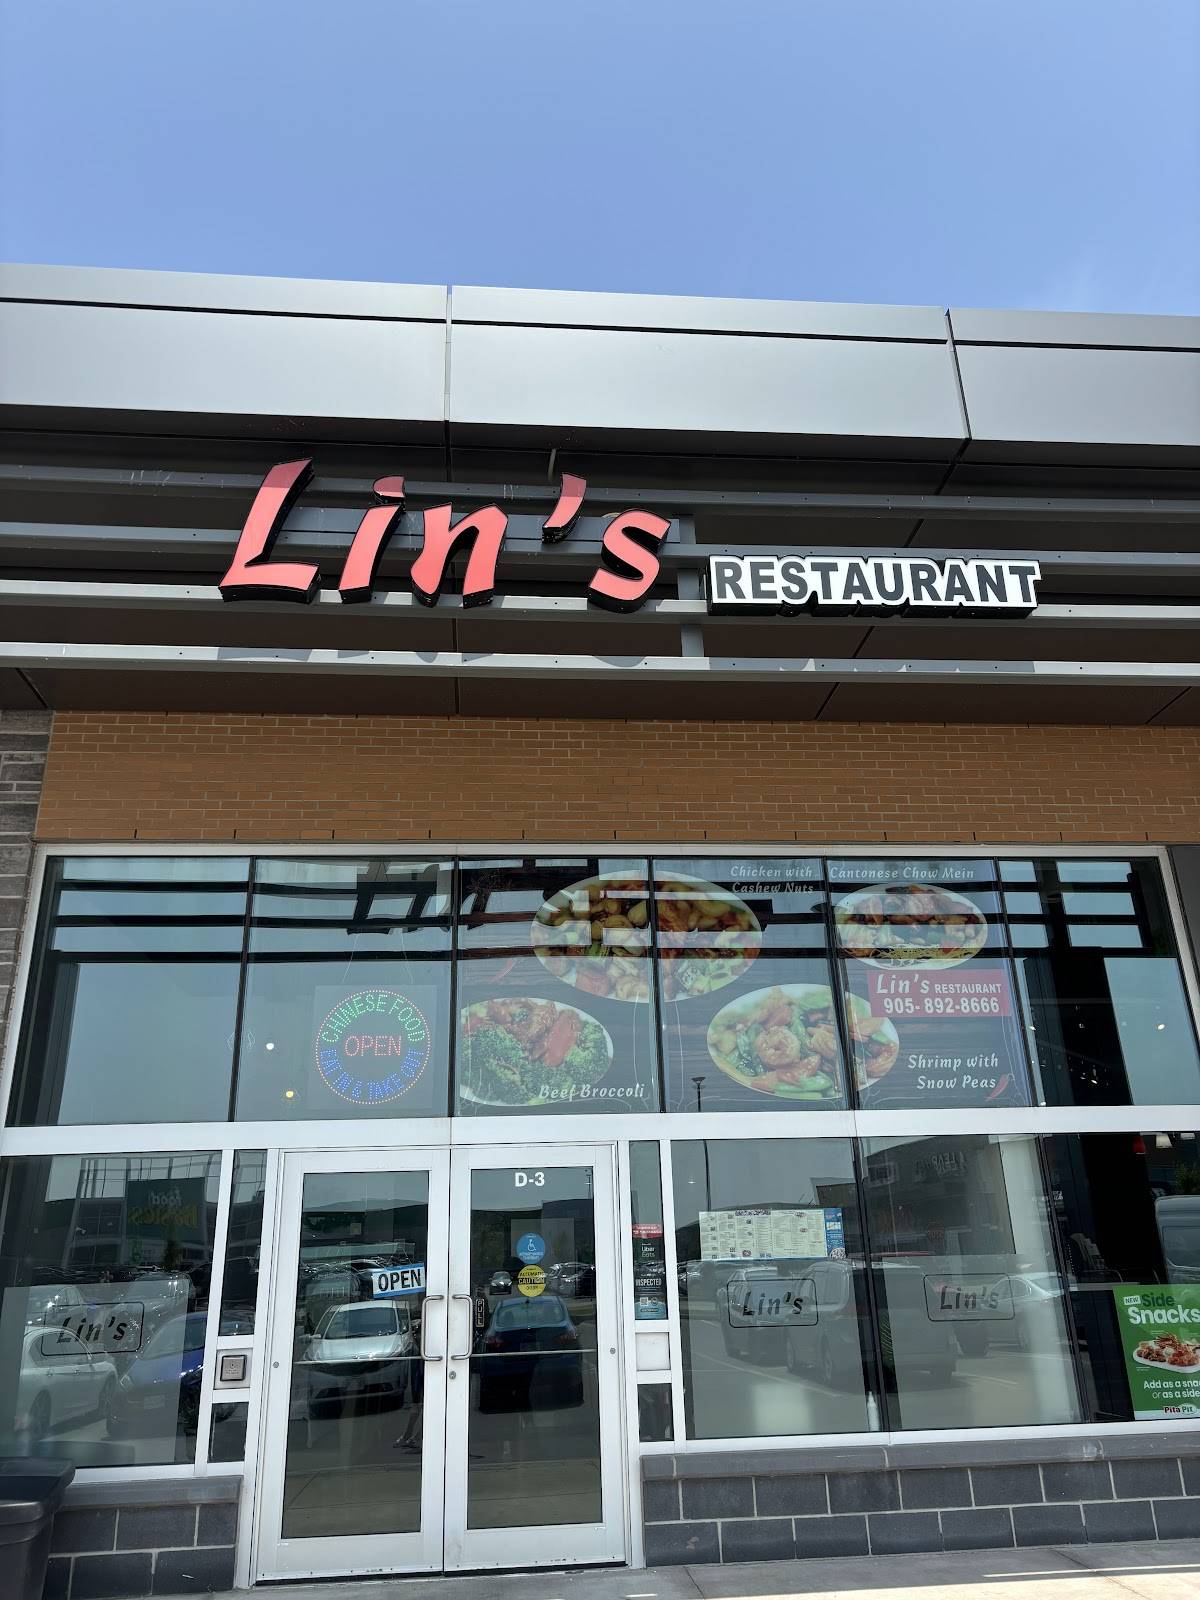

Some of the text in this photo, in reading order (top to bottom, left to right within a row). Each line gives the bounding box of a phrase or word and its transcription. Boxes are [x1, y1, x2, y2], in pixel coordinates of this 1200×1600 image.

[219, 457, 1037, 609] Lin's RESTAURANT
[730, 865, 813, 878] Chicken with
[830, 866, 975, 879] Cantonese Chow Mein
[732, 881, 815, 895] Cashew Nuts
[876, 973, 1002, 994] Lin's RESTAURANT
[321, 993, 426, 1043] CHINESE FOOD
[344, 1035, 402, 1057] OPEN
[907, 1053, 999, 1071] Shrimp with
[916, 1074, 997, 1090] Snow Peas
[539, 1083, 645, 1102] Beef Broccoli
[514, 1171, 545, 1187] D-3
[377, 1268, 422, 1292] OPEN
[742, 1291, 804, 1316] Lin's
[940, 1285, 999, 1310] Lin's
[1141, 1292, 1175, 1307] Side
[1128, 1304, 1200, 1324] Snacks
[56, 1316, 127, 1344] Lin's
[1143, 1380, 1161, 1389] Add
[1182, 1380, 1200, 1388] sna
[1152, 1391, 1161, 1399] or
[1182, 1389, 1200, 1398] side
[1182, 1405, 1193, 1413] Pit
